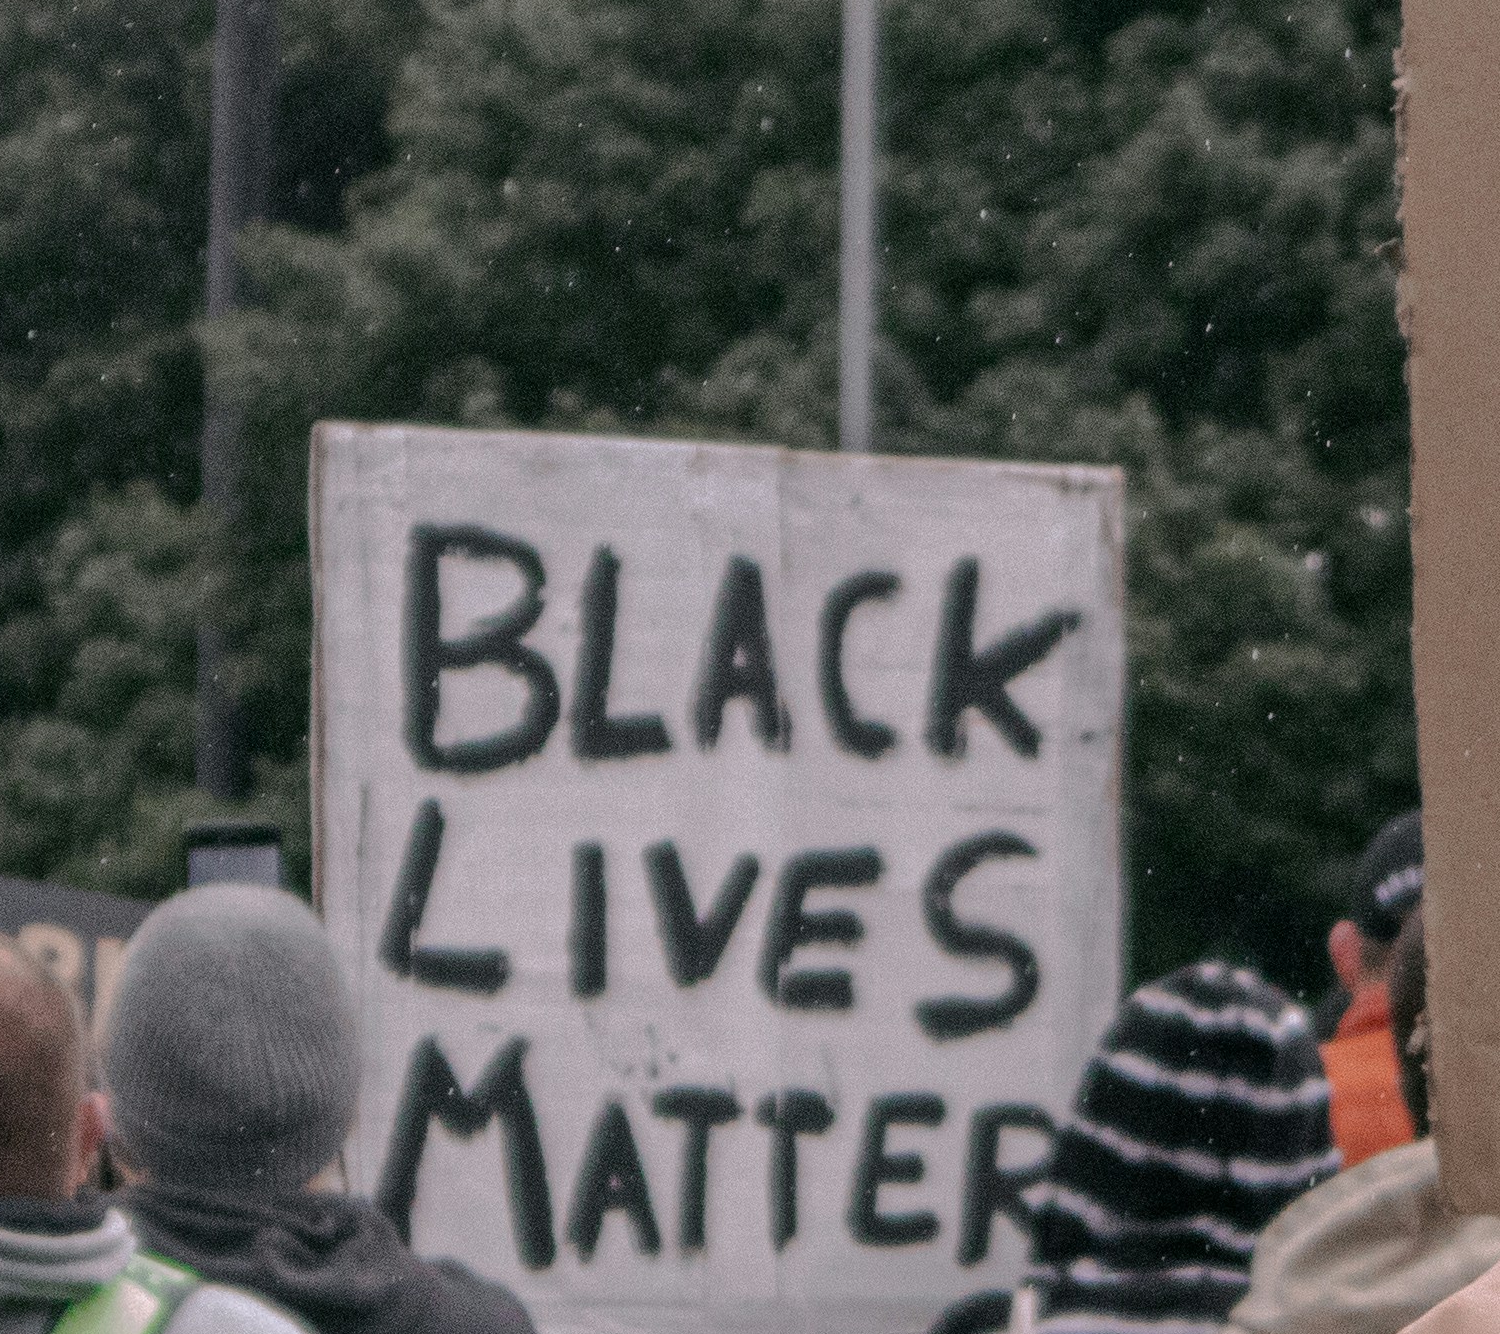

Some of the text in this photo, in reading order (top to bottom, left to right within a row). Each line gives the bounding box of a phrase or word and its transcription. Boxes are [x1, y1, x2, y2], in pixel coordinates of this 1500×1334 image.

[402, 521, 1083, 775] BLACK
[380, 798, 1042, 1041] LIVES
[373, 1033, 1062, 1271] MATTER
